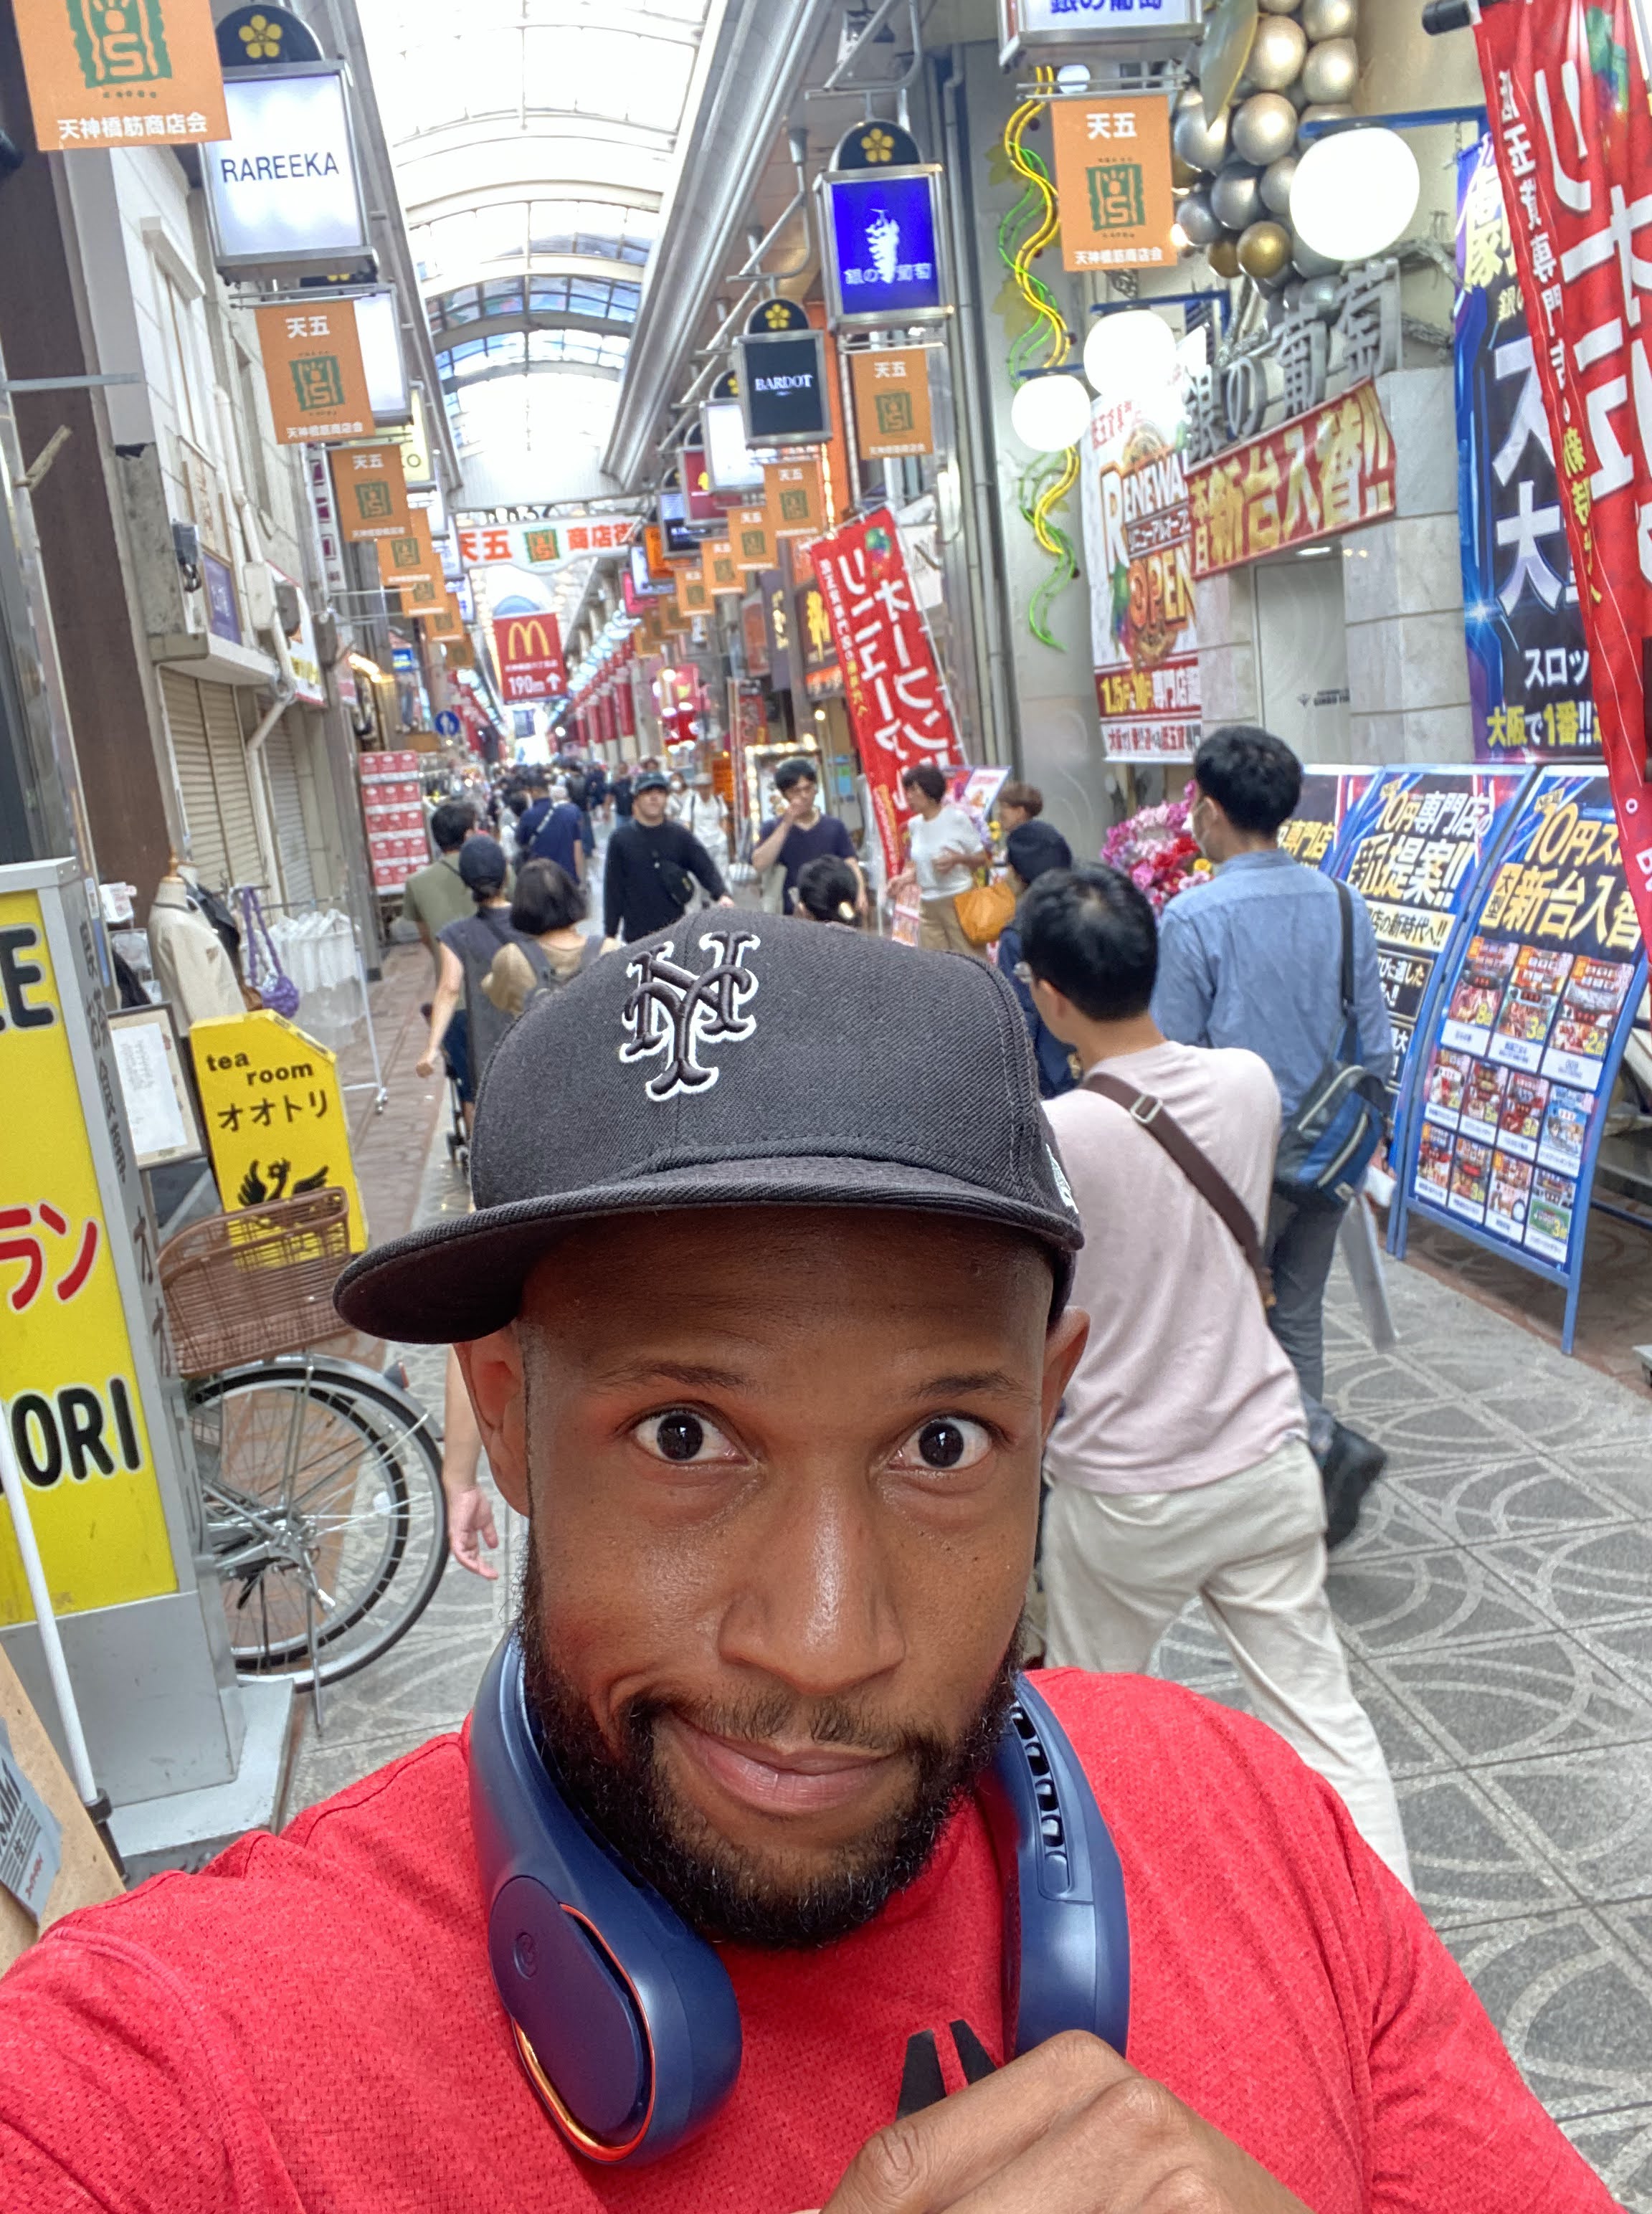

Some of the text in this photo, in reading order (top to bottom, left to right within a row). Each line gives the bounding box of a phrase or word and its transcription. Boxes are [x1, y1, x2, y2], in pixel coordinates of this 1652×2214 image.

[57, 112, 208, 141] 天神橋筋商店会
[1086, 112, 1138, 140] 天五
[221, 151, 339, 184] RAREEKA
[285, 315, 331, 338] 天五
[755, 374, 813, 392] BARDOT
[873, 361, 907, 379] 天五
[458, 528, 513, 563] 天五
[1370, 905, 1448, 948] 店の新時代へ!!
[0, 928, 54, 1031] E
[206, 1052, 250, 1073] tea
[247, 1063, 314, 1086] room
[217, 1088, 329, 1134] オオトリ
[0, 1377, 141, 1496] ORI
